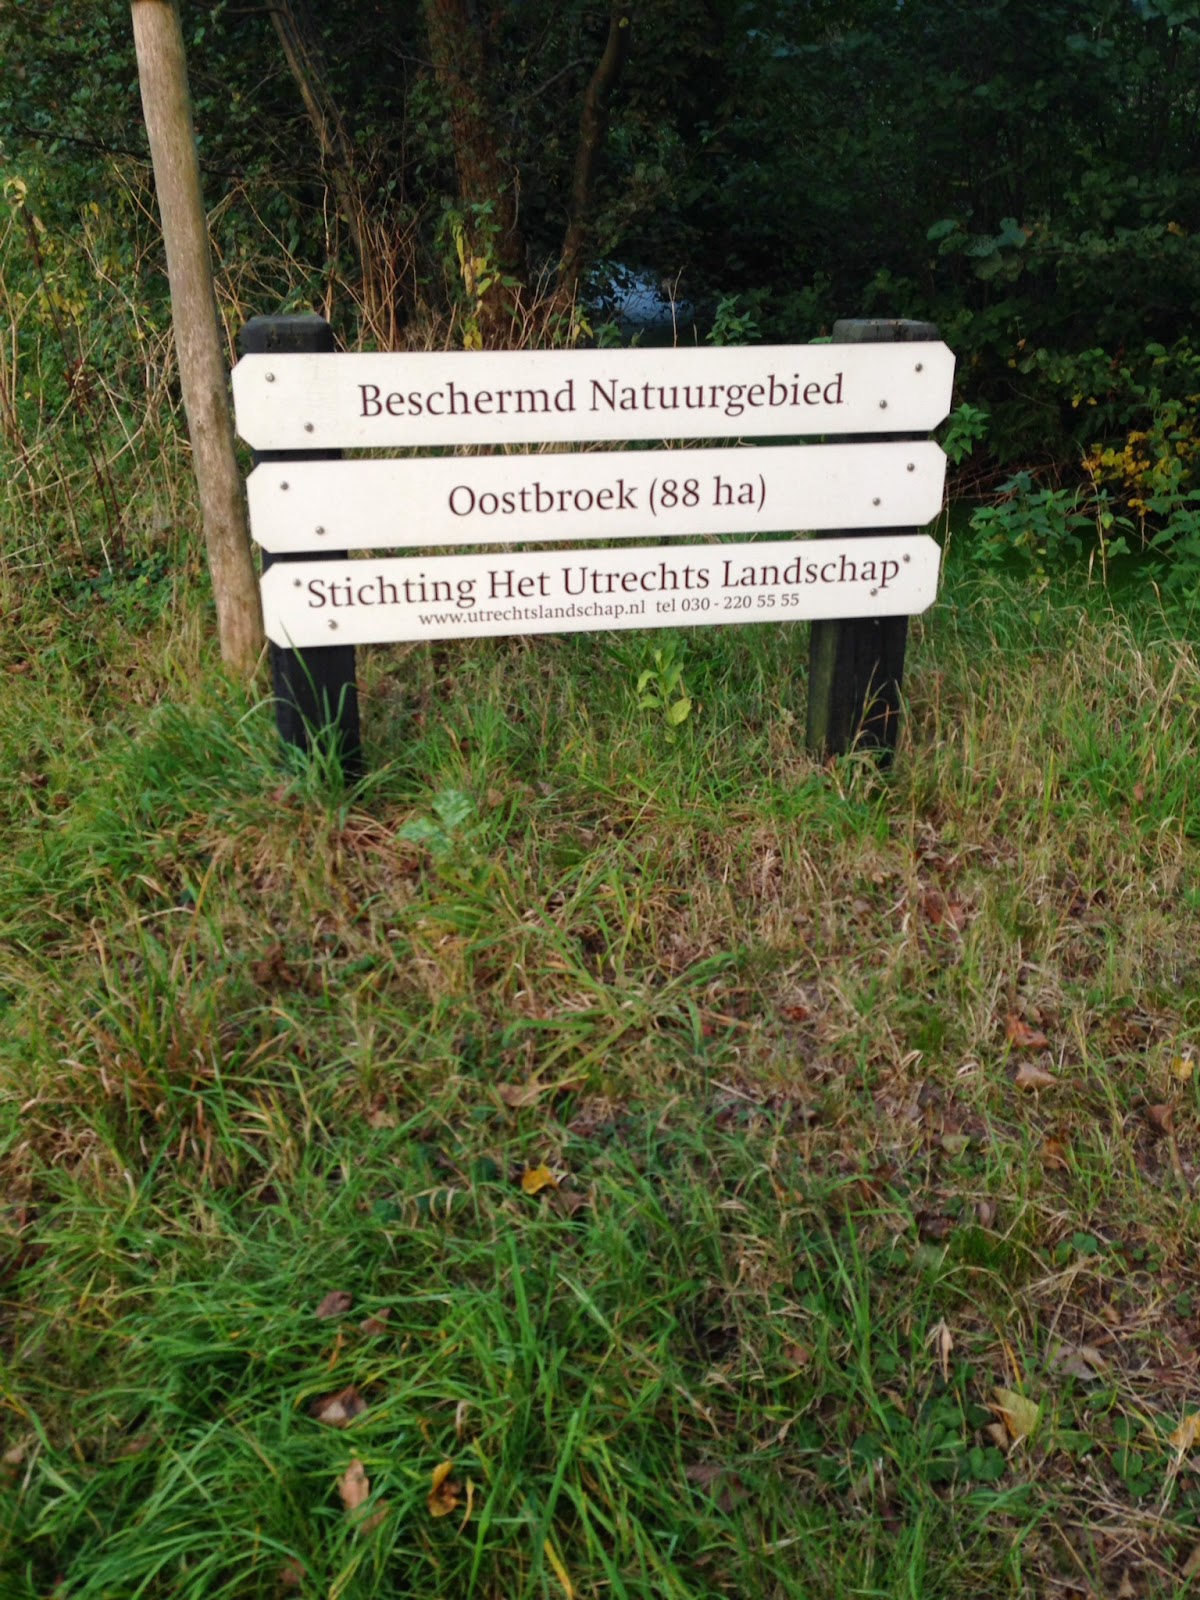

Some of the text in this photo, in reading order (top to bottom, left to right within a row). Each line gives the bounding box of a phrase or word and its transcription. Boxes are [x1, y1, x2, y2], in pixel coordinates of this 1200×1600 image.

[358, 372, 844, 417] Beschermd Natuurgebied
[448, 474, 767, 517] Oostbroek (88 ha)
[308, 554, 900, 609] Stichting Het Utrechts Landschap
[418, 600, 646, 626] www.utrechtslandschap.nl
[656, 598, 677, 613] tel
[681, 597, 711, 612] 030
[724, 595, 752, 609] 220
[757, 594, 776, 608] 55
[781, 593, 800, 606] 55
